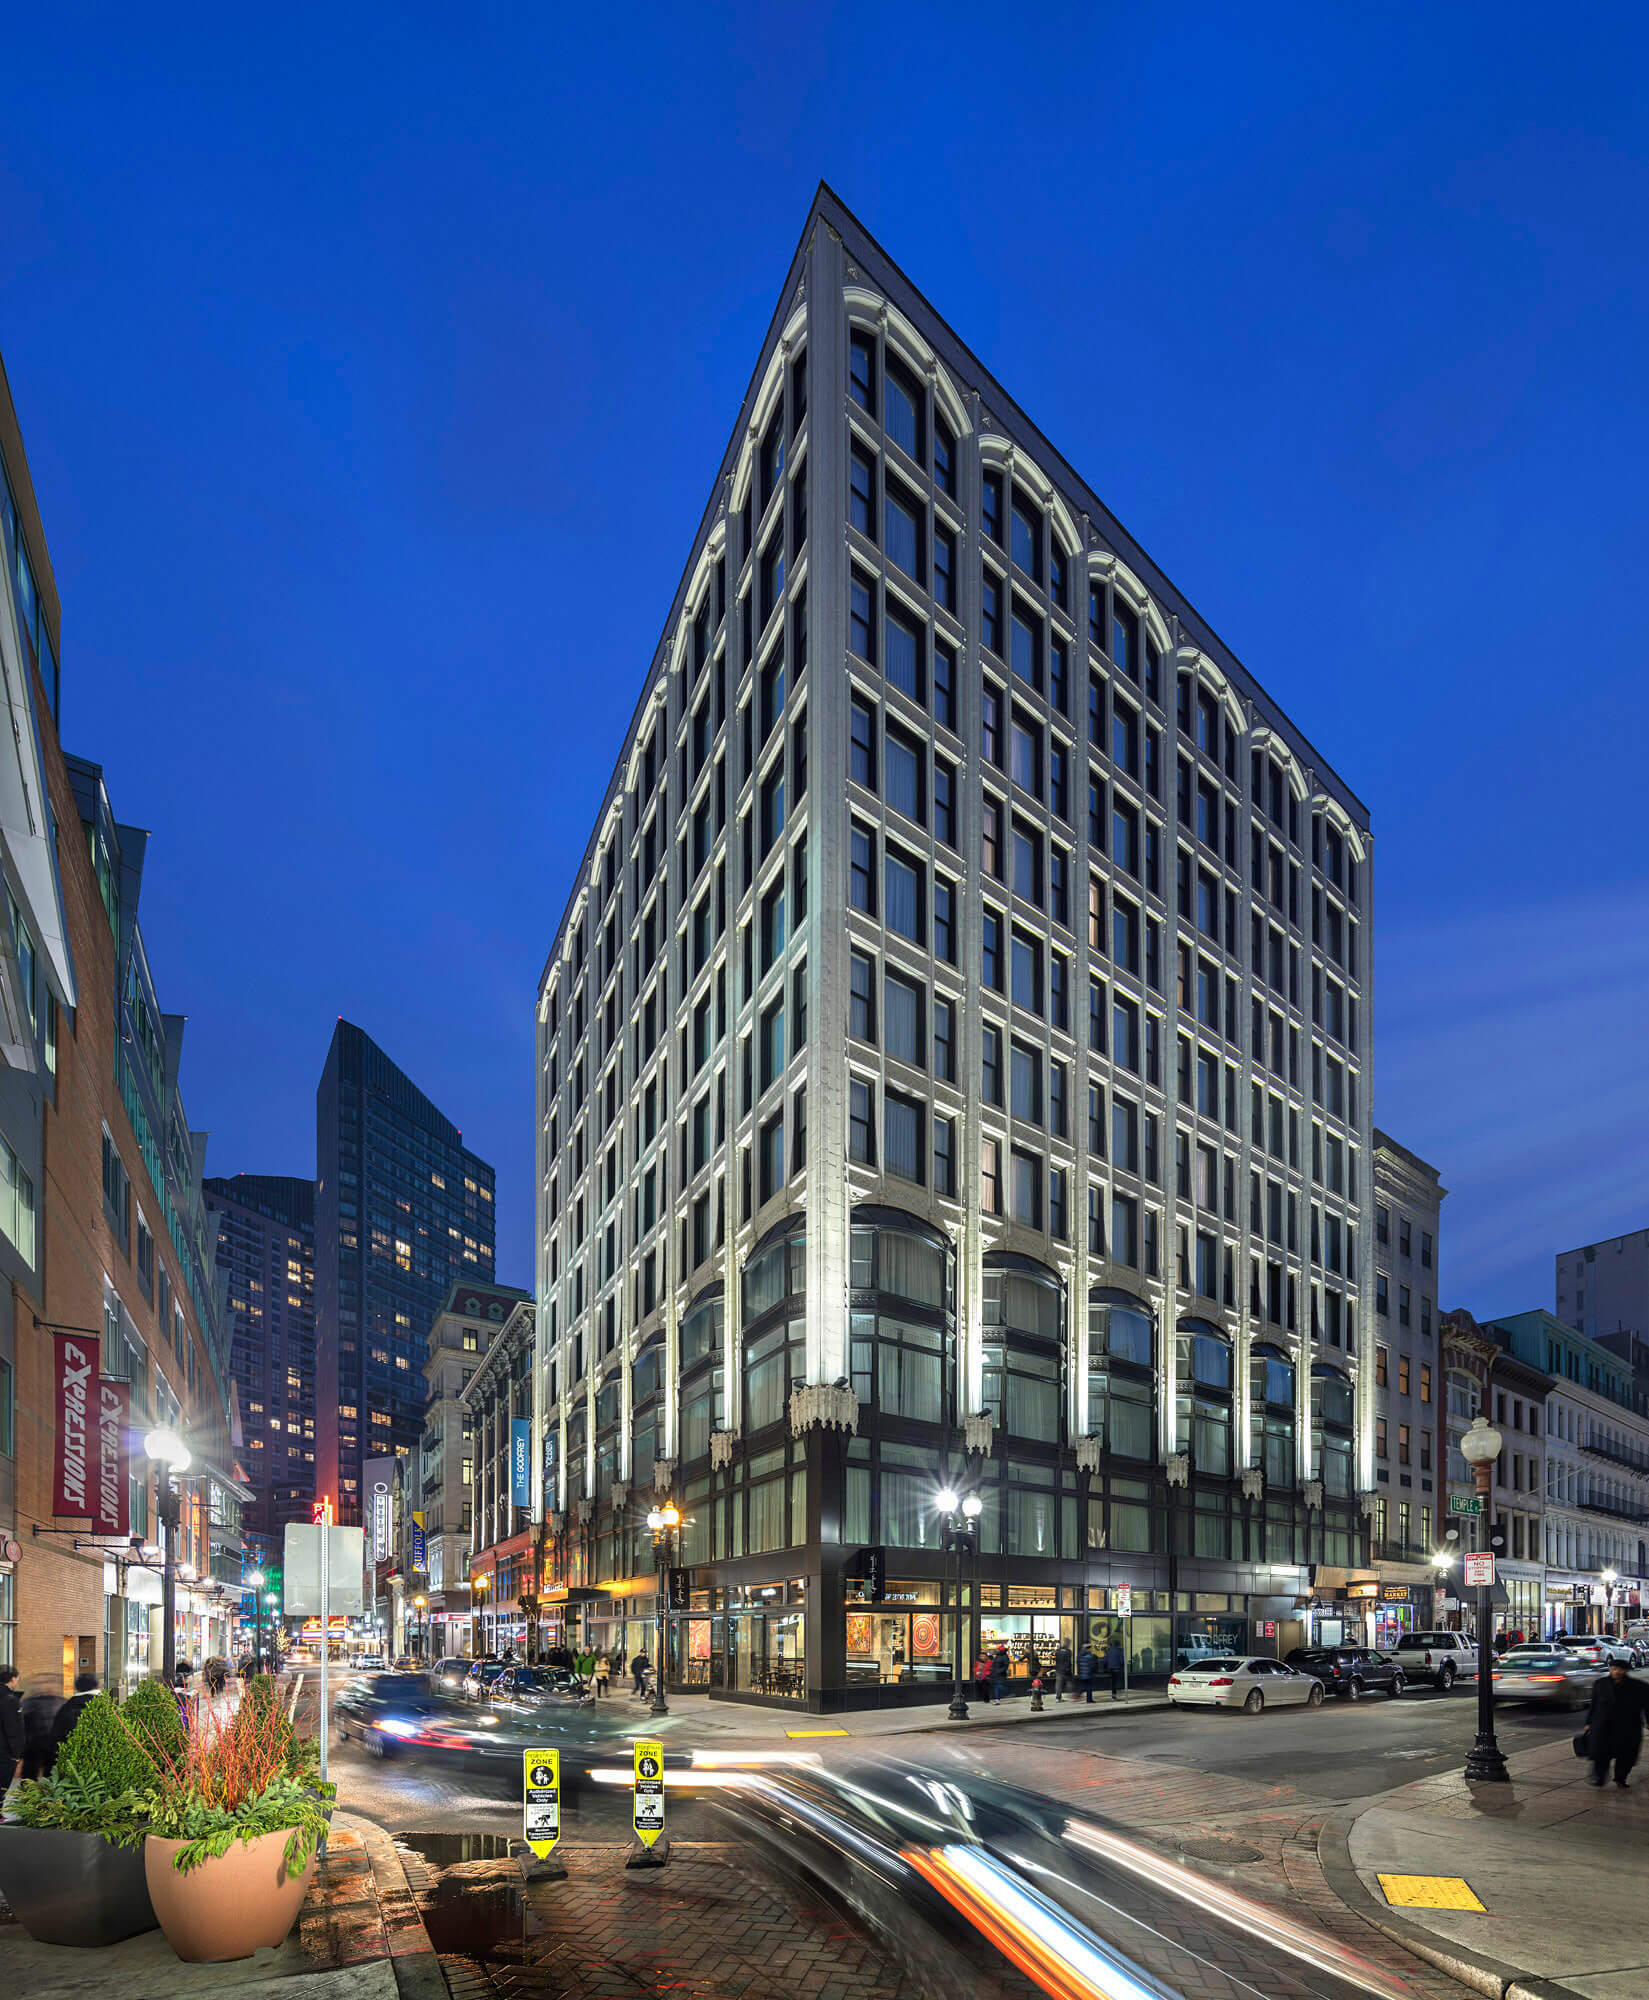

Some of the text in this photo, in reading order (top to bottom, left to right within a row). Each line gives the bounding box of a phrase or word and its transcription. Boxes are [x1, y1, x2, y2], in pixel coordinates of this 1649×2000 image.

[62, 1341, 91, 1510] EXPRESSIONS
[99, 1386, 123, 1529] EXPRESSIONS
[516, 1436, 525, 1488] THE GODFREY
[1453, 1496, 1474, 1512] TEMPLE
[414, 1526, 423, 1568] SUFFOLK
